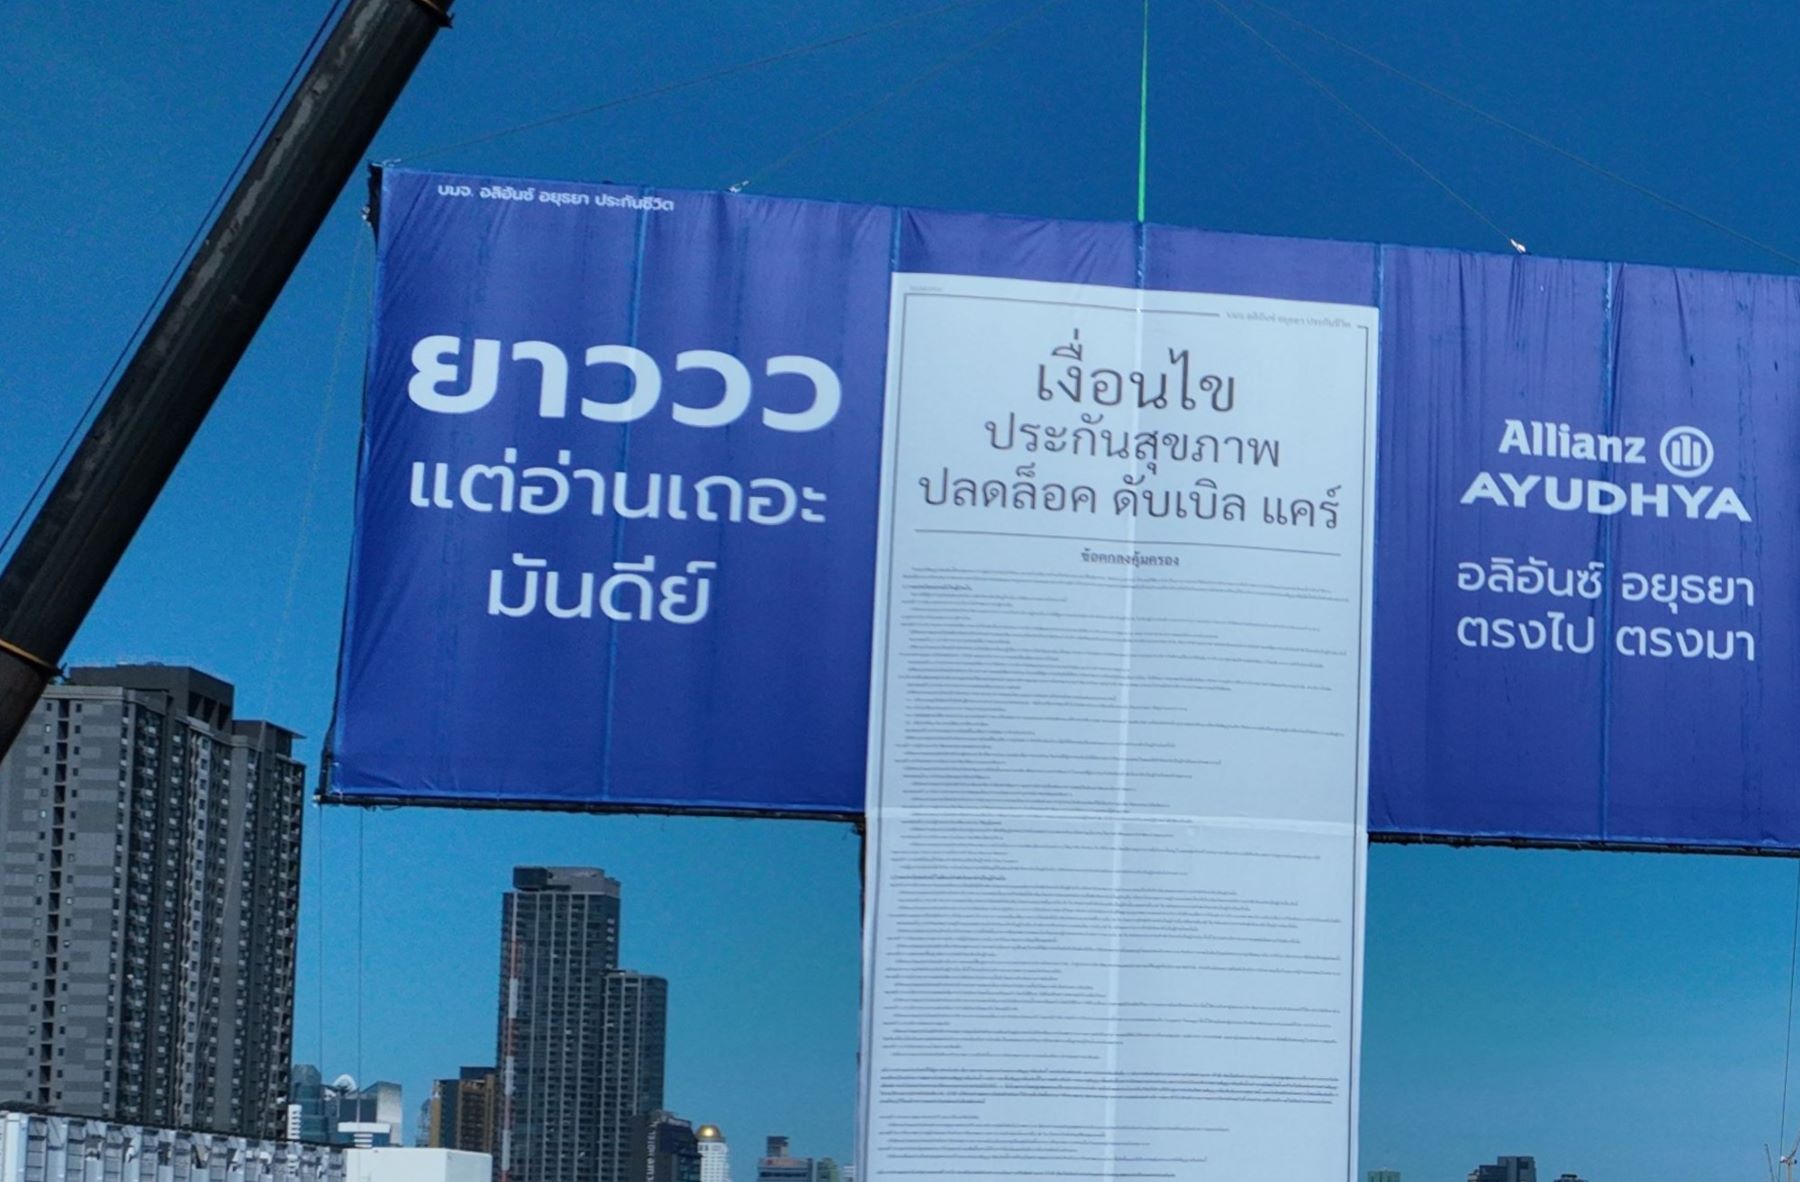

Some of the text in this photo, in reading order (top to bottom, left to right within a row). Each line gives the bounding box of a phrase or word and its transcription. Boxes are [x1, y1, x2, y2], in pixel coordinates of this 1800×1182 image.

[539, 190, 589, 207] อยุธยา
[408, 334, 842, 432] ยาววว
[1037, 328, 1235, 412] เงื่อนไข
[983, 412, 1280, 474] ประกันสุขภาพ
[1499, 419, 1646, 464] Allianz
[409, 447, 827, 525] แต่อ่านเถอะ
[918, 462, 1342, 529] ปลดล็อค ดับเบิล แคร์
[1459, 471, 1752, 522] AYUDHYA
[488, 553, 717, 624] มันดีย์
[1457, 556, 1755, 614] อลิอันซ์ อยุธยา
[1457, 611, 1755, 661] ตรงไป ตรงมา
